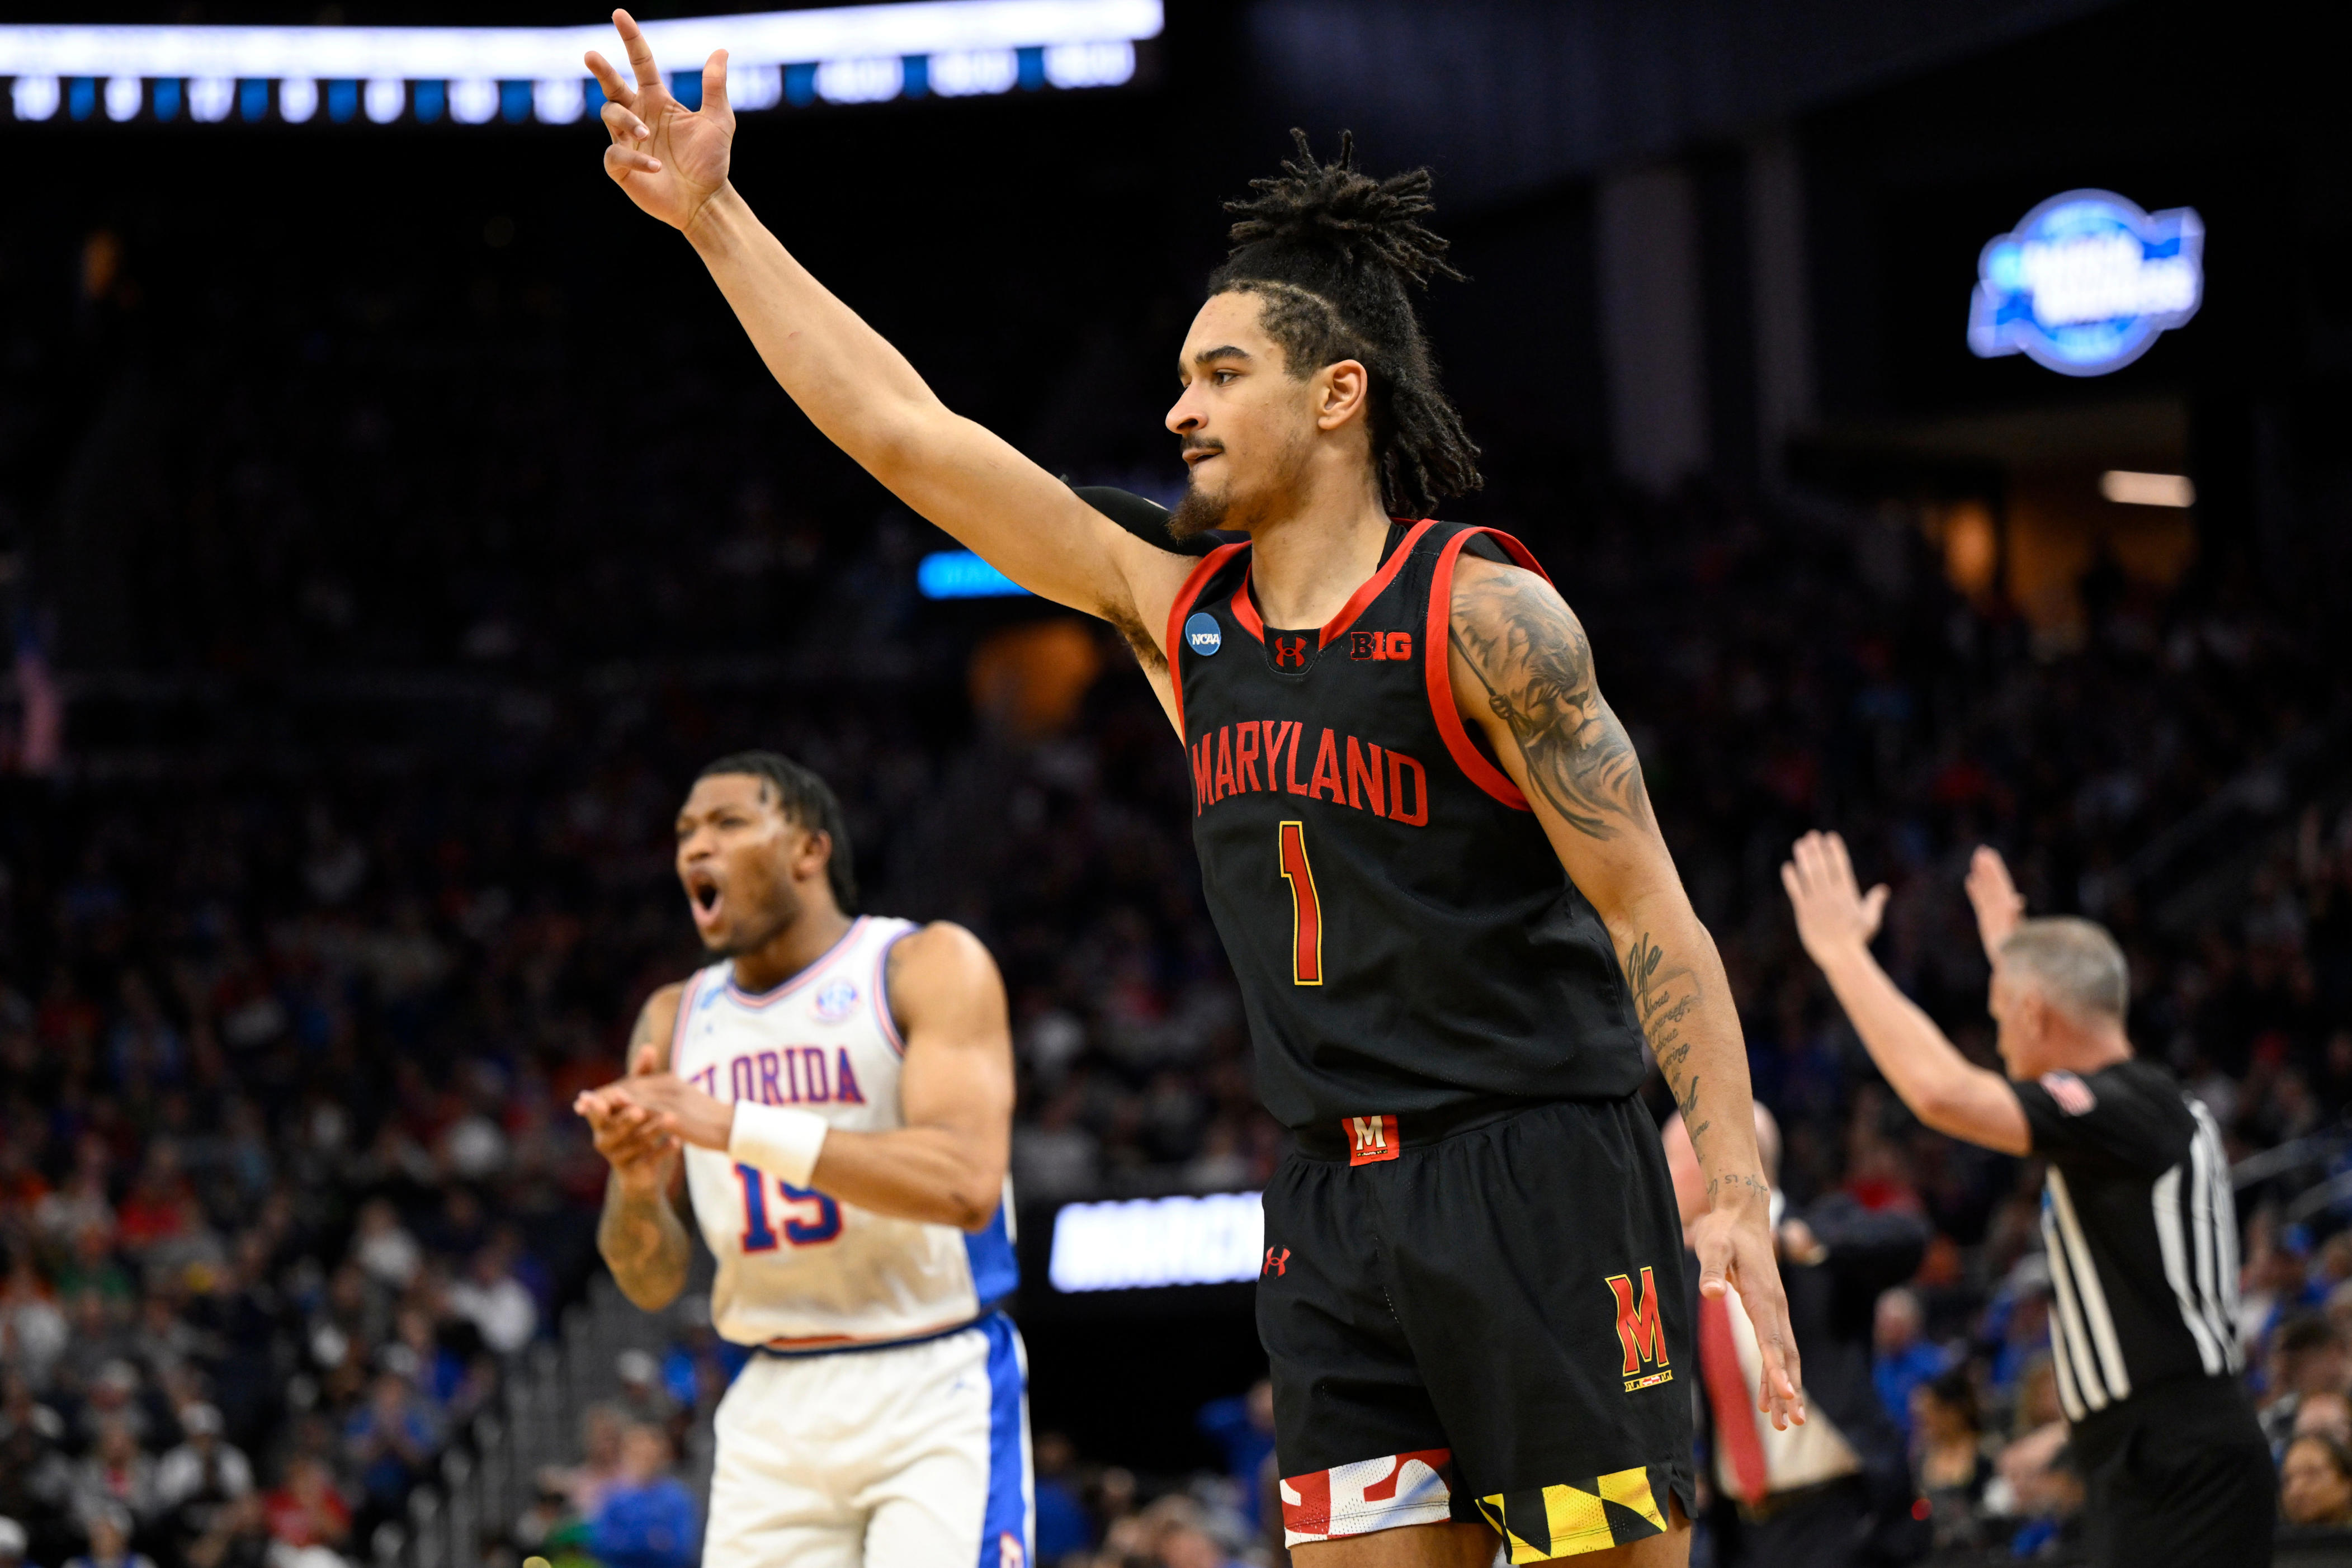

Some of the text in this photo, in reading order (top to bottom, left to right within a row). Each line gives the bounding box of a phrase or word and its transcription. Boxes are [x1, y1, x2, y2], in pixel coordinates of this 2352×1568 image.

[1192, 633, 1220, 645] NCAA
[1192, 720, 1428, 827] MARYLAND
[1279, 821, 1323, 985] 1
[688, 1047, 866, 1106] ORIDA
[1352, 1115, 1387, 1151] M
[1604, 1266, 1670, 1377] M
